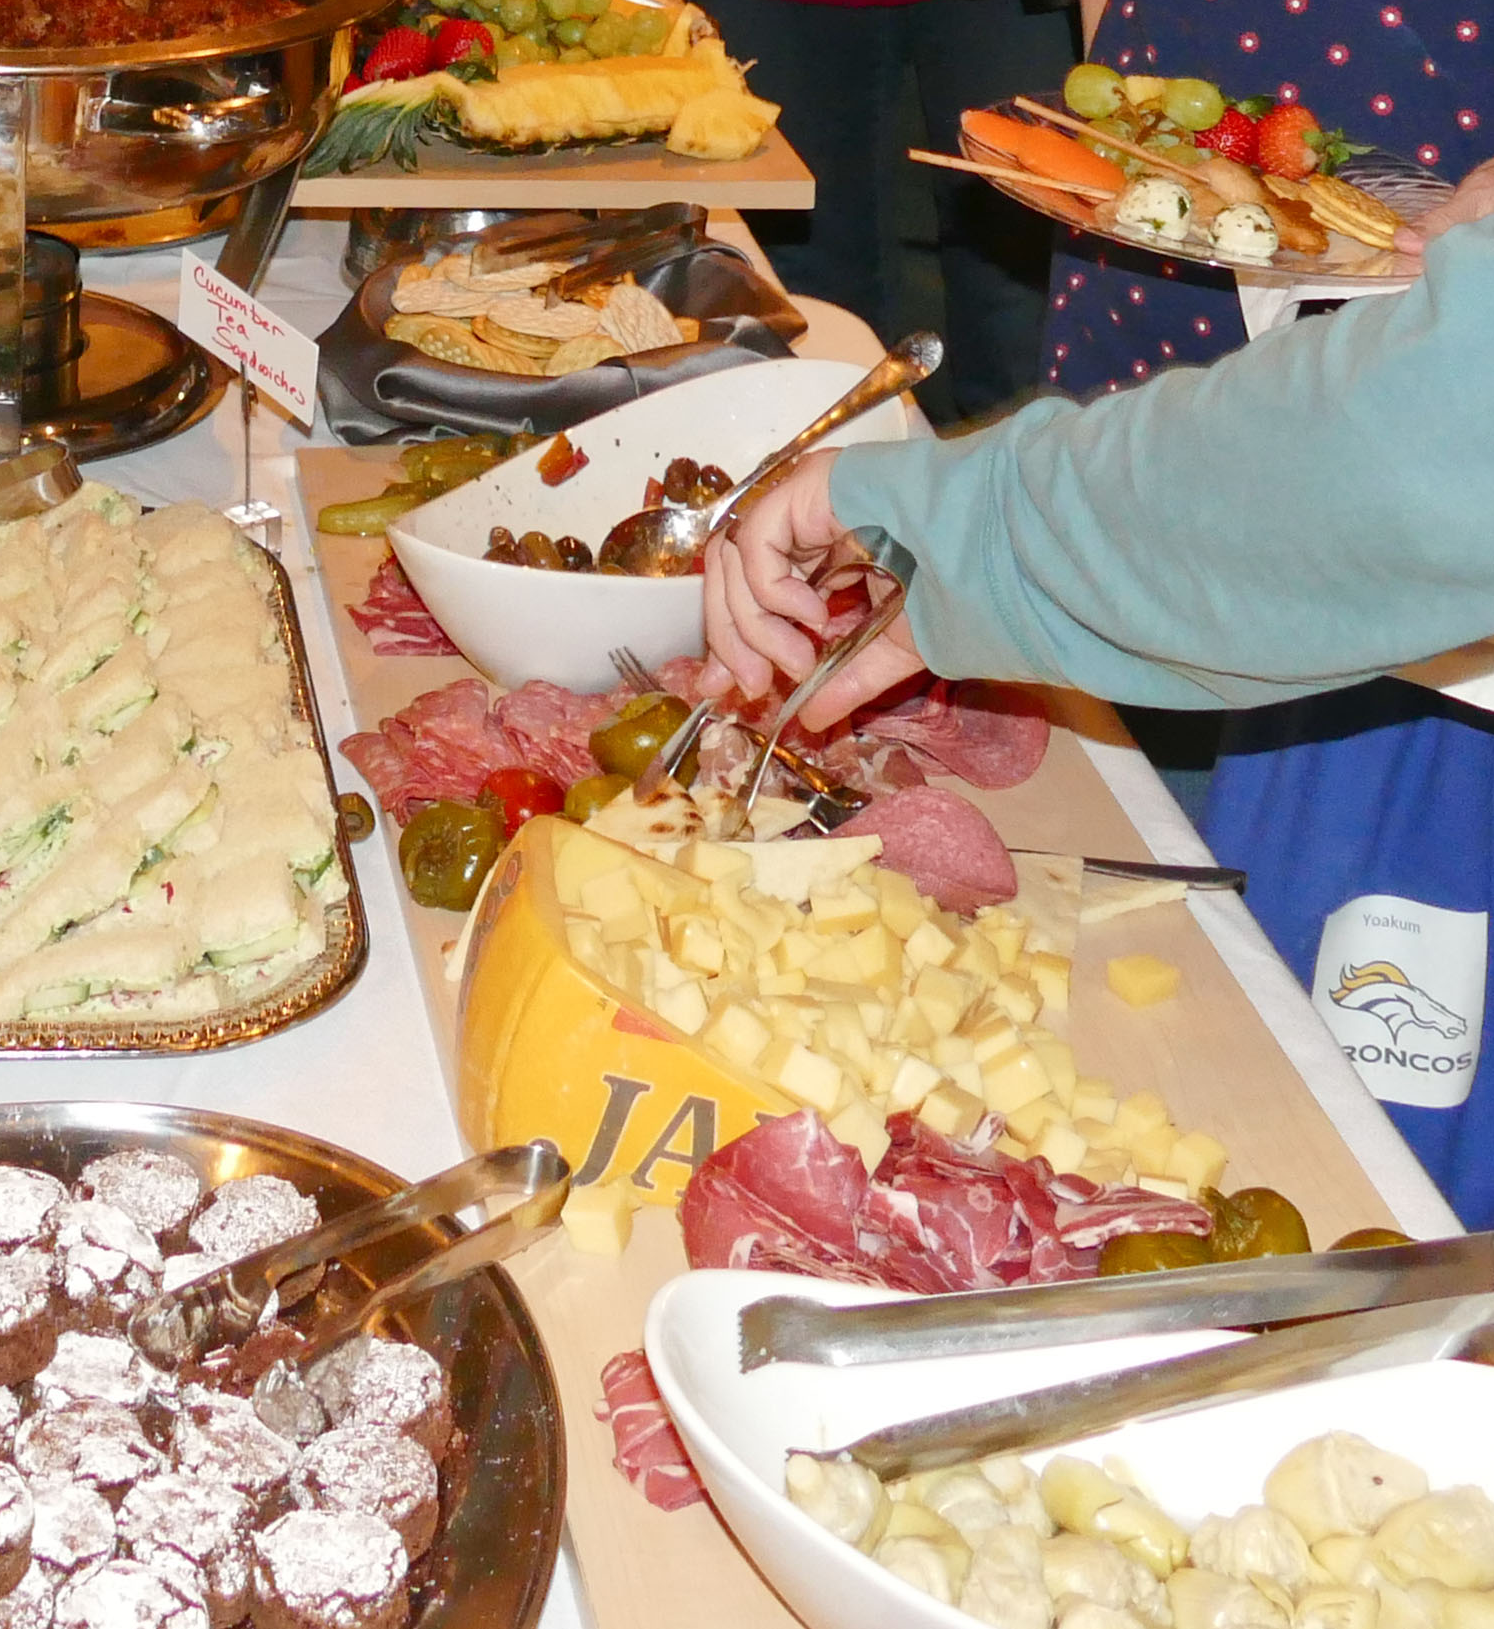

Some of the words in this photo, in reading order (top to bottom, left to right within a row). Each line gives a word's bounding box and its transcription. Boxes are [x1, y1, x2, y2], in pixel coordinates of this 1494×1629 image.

[193, 266, 285, 338] Cucumber
[207, 298, 250, 341] Tea
[212, 326, 306, 406] Sandwiches
[1362, 912, 1421, 935] Yoakum
[1340, 1044, 1473, 1074] RONCOS
[528, 1074, 778, 1198] JA
